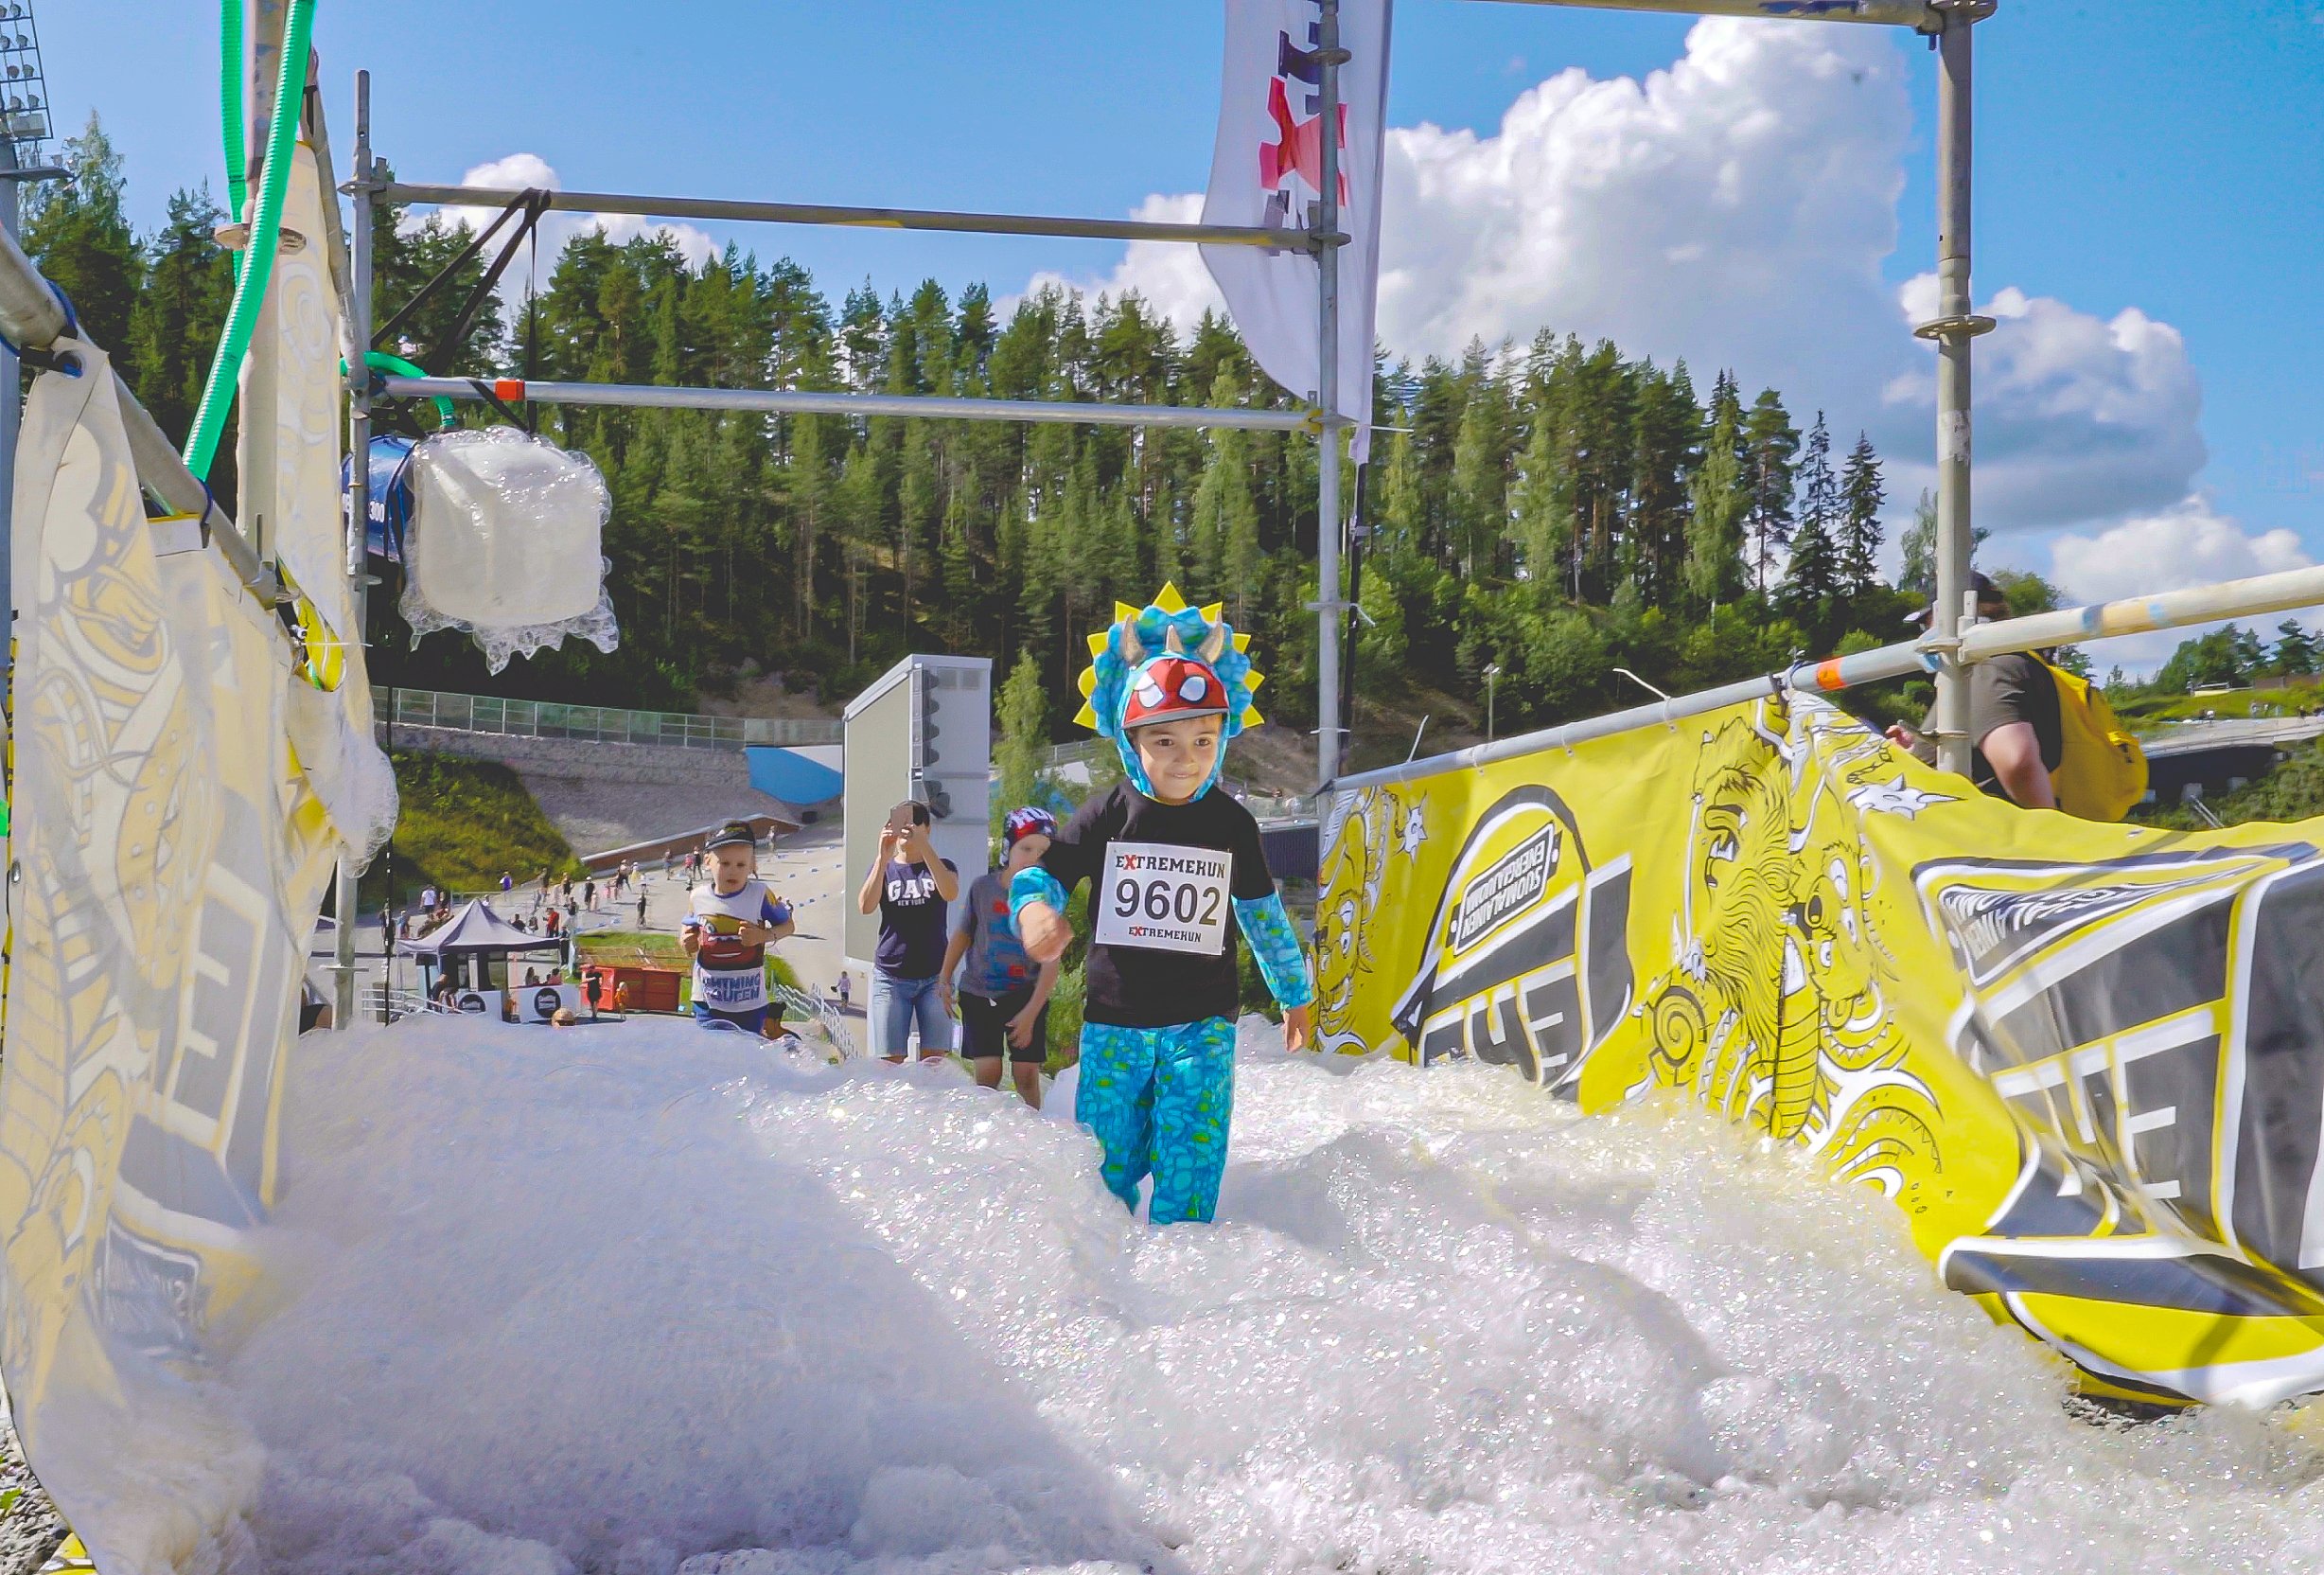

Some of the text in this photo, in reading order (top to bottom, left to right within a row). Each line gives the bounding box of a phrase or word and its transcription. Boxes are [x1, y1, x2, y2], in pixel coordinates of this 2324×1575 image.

[1116, 855, 1225, 878] EXTREMERUN
[888, 878, 935, 902] GAP
[1115, 878, 1221, 926] 9602
[1128, 927, 1202, 943] EXTREMERUN
